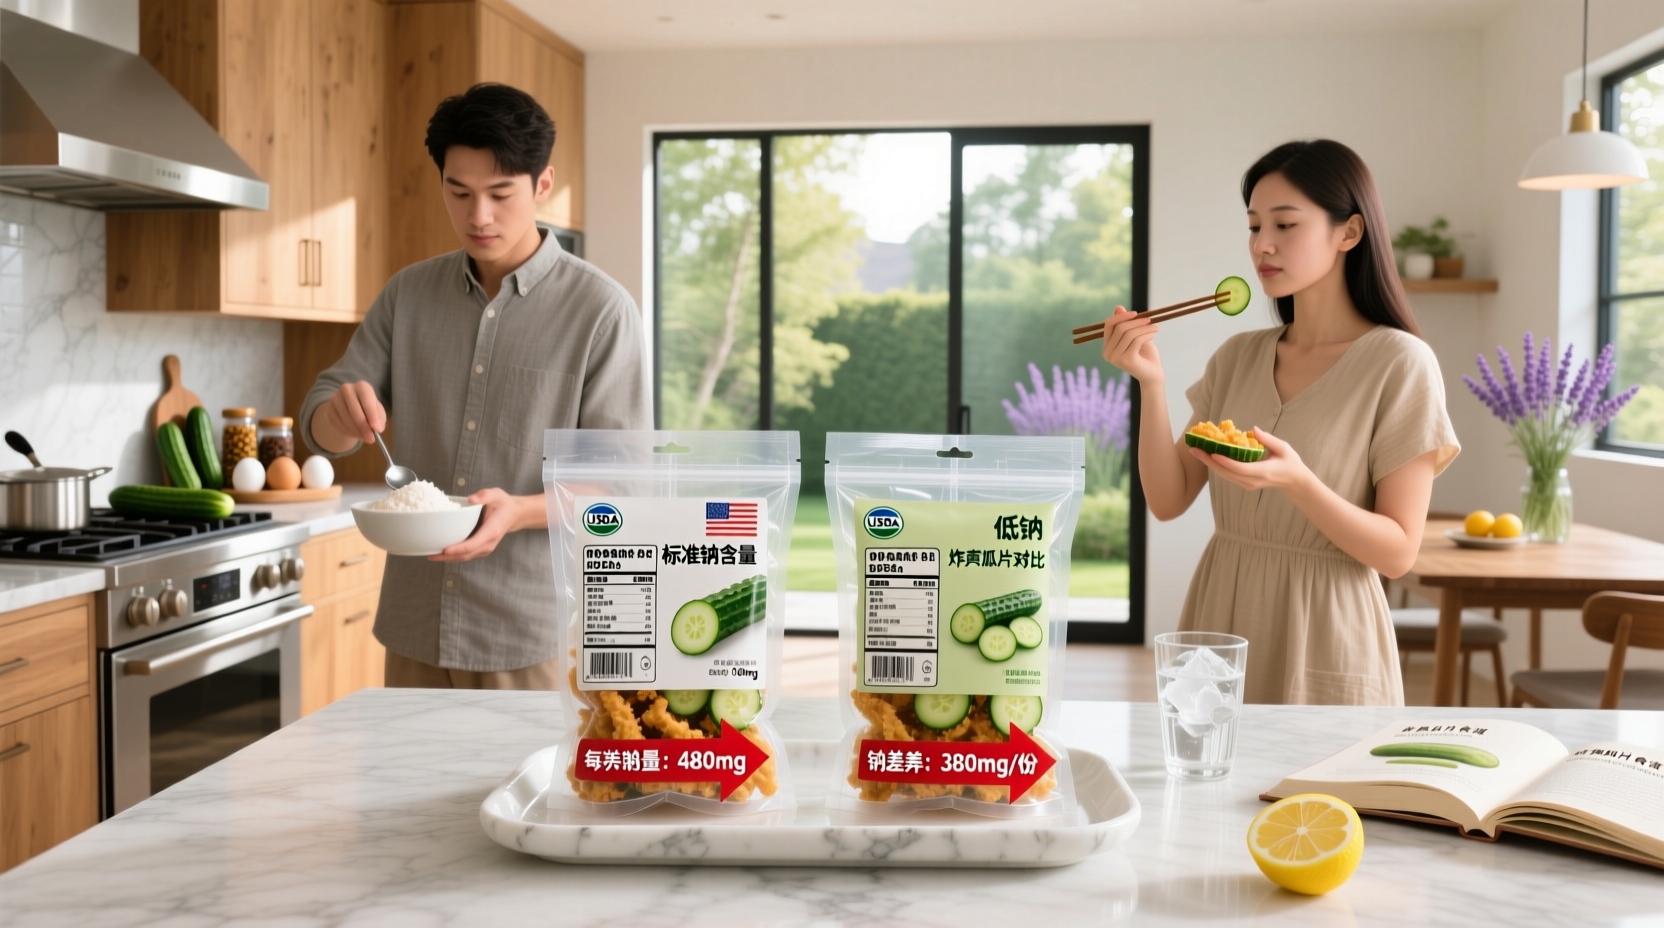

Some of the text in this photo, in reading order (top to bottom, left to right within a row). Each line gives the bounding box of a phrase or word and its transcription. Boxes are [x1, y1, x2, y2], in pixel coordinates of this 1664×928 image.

[587, 512, 620, 525] USDA
[867, 516, 900, 528] USDA
[994, 515, 1043, 540] 低钠
[661, 543, 757, 565] 标准钠含量
[677, 751, 746, 775] 480mg
[940, 752, 1038, 778] 380mg/份
